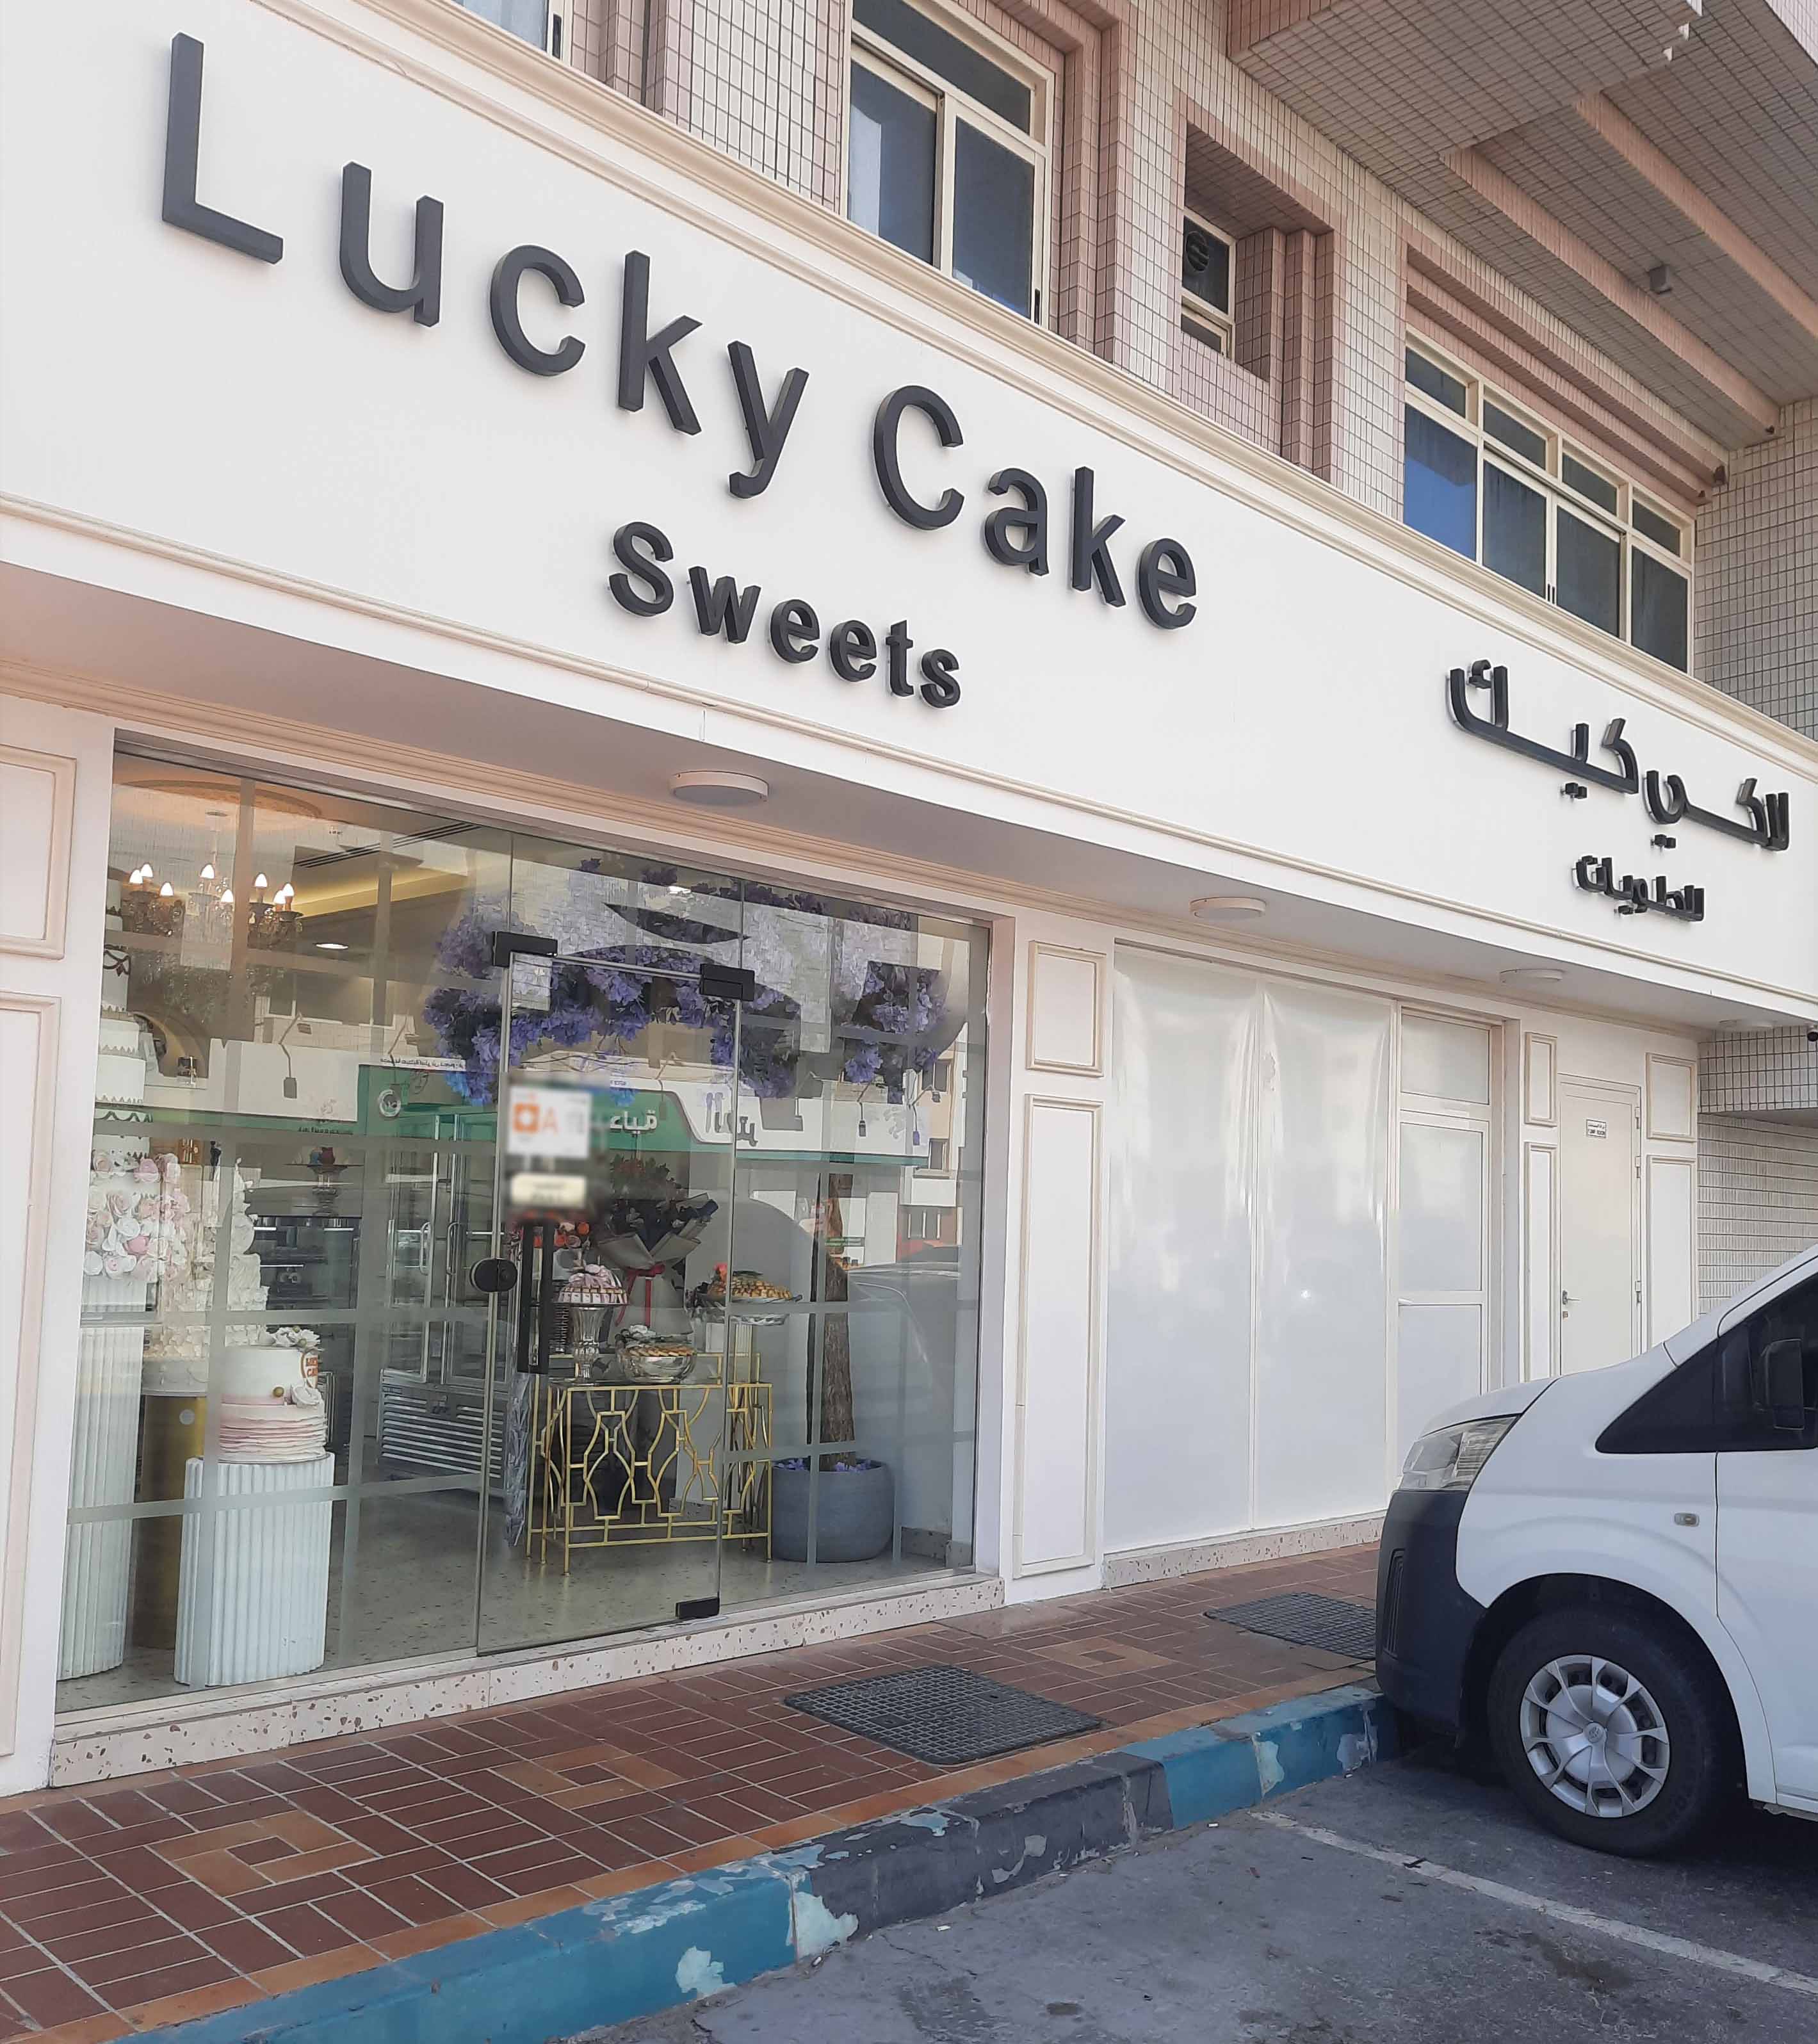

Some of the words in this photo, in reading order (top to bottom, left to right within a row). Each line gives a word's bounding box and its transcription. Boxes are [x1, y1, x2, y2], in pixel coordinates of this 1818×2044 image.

[162, 32, 809, 499] Lucky
[873, 385, 1197, 630] Cake
[608, 521, 961, 709] Sweets
[1450, 659, 1639, 800] كيك
[1643, 770, 1790, 851] لاكي
[1575, 855, 1705, 922] للحلويات
